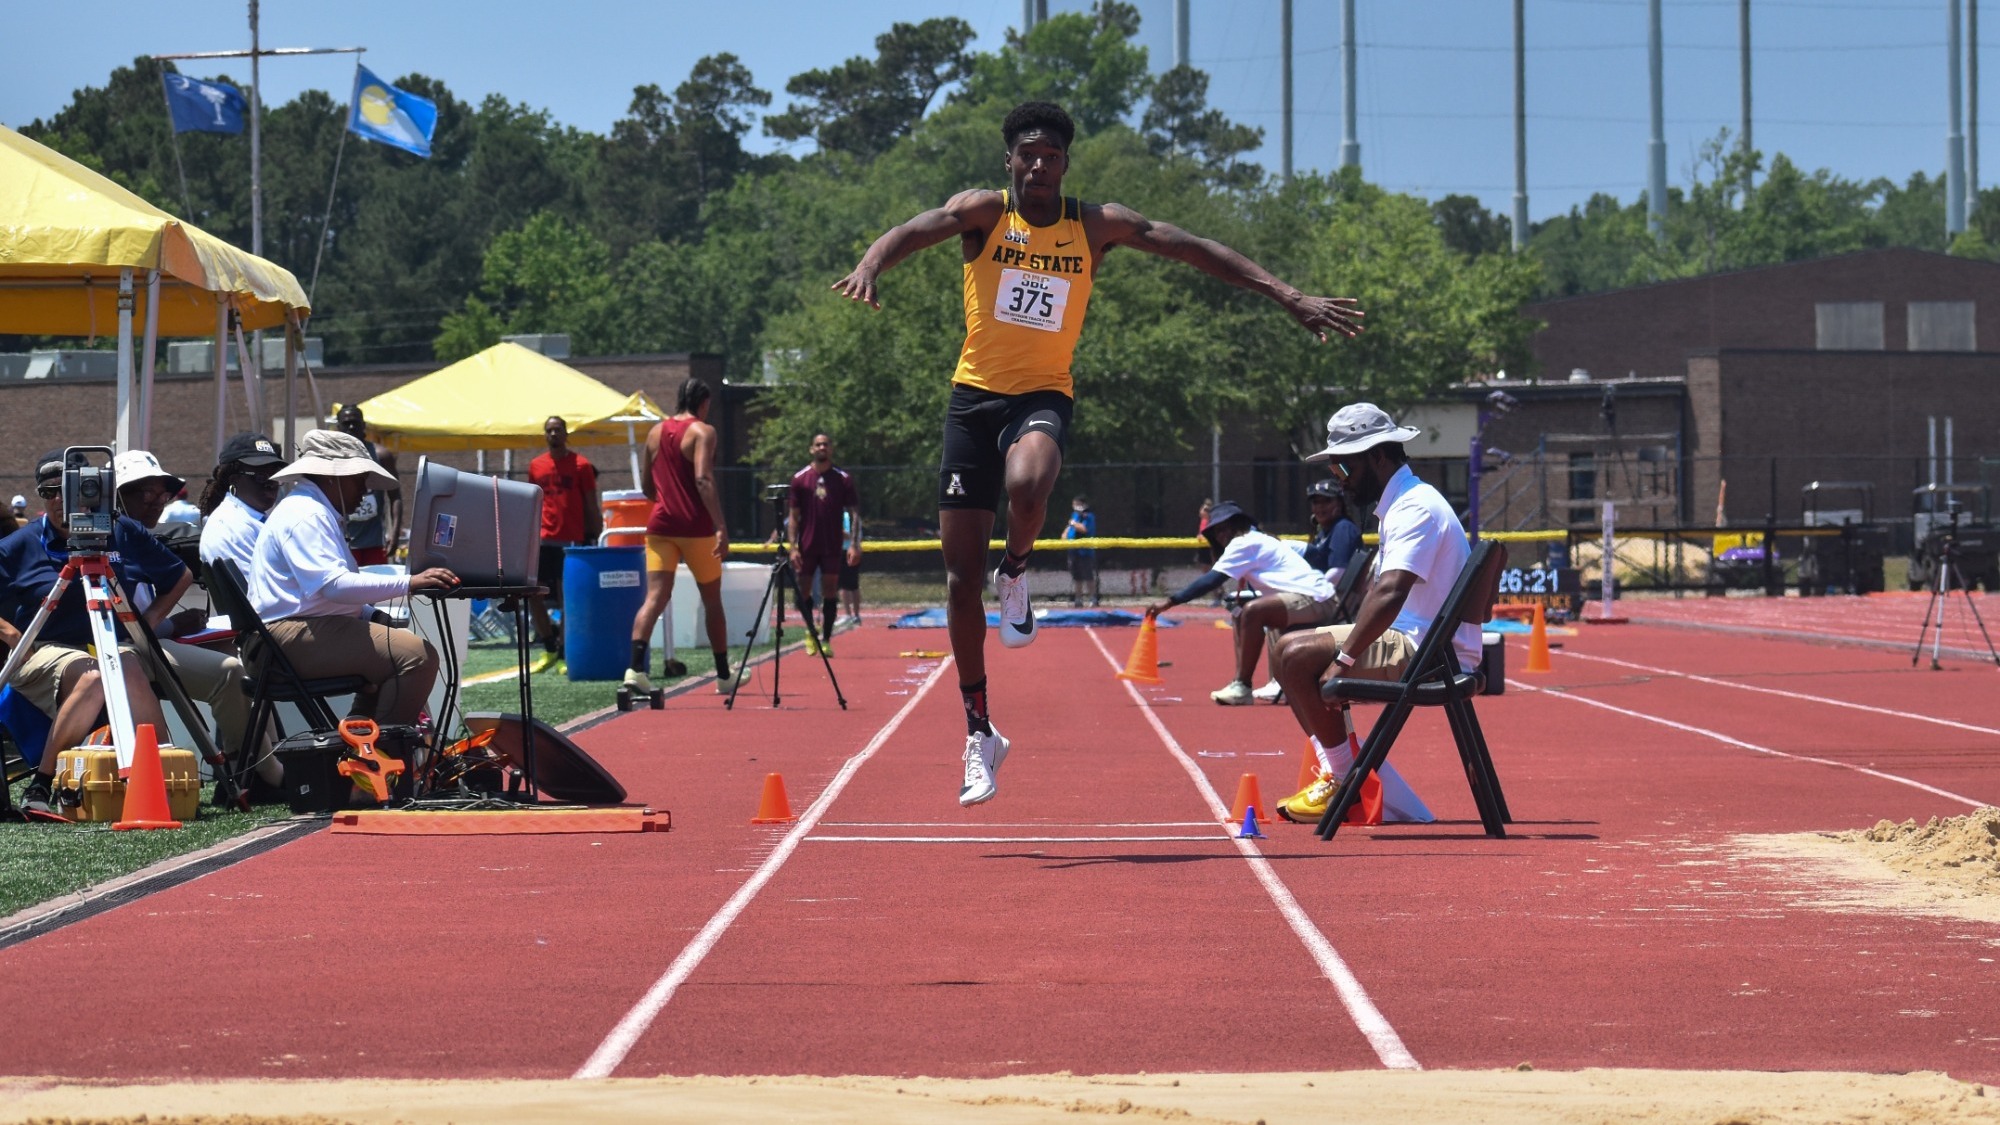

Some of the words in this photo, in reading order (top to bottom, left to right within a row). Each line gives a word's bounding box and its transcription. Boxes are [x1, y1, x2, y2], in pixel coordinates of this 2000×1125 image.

[992, 245, 1026, 267] APP
[1029, 253, 1083, 274] STATE
[1021, 273, 1050, 290] SBC
[1008, 286, 1054, 318] 375
